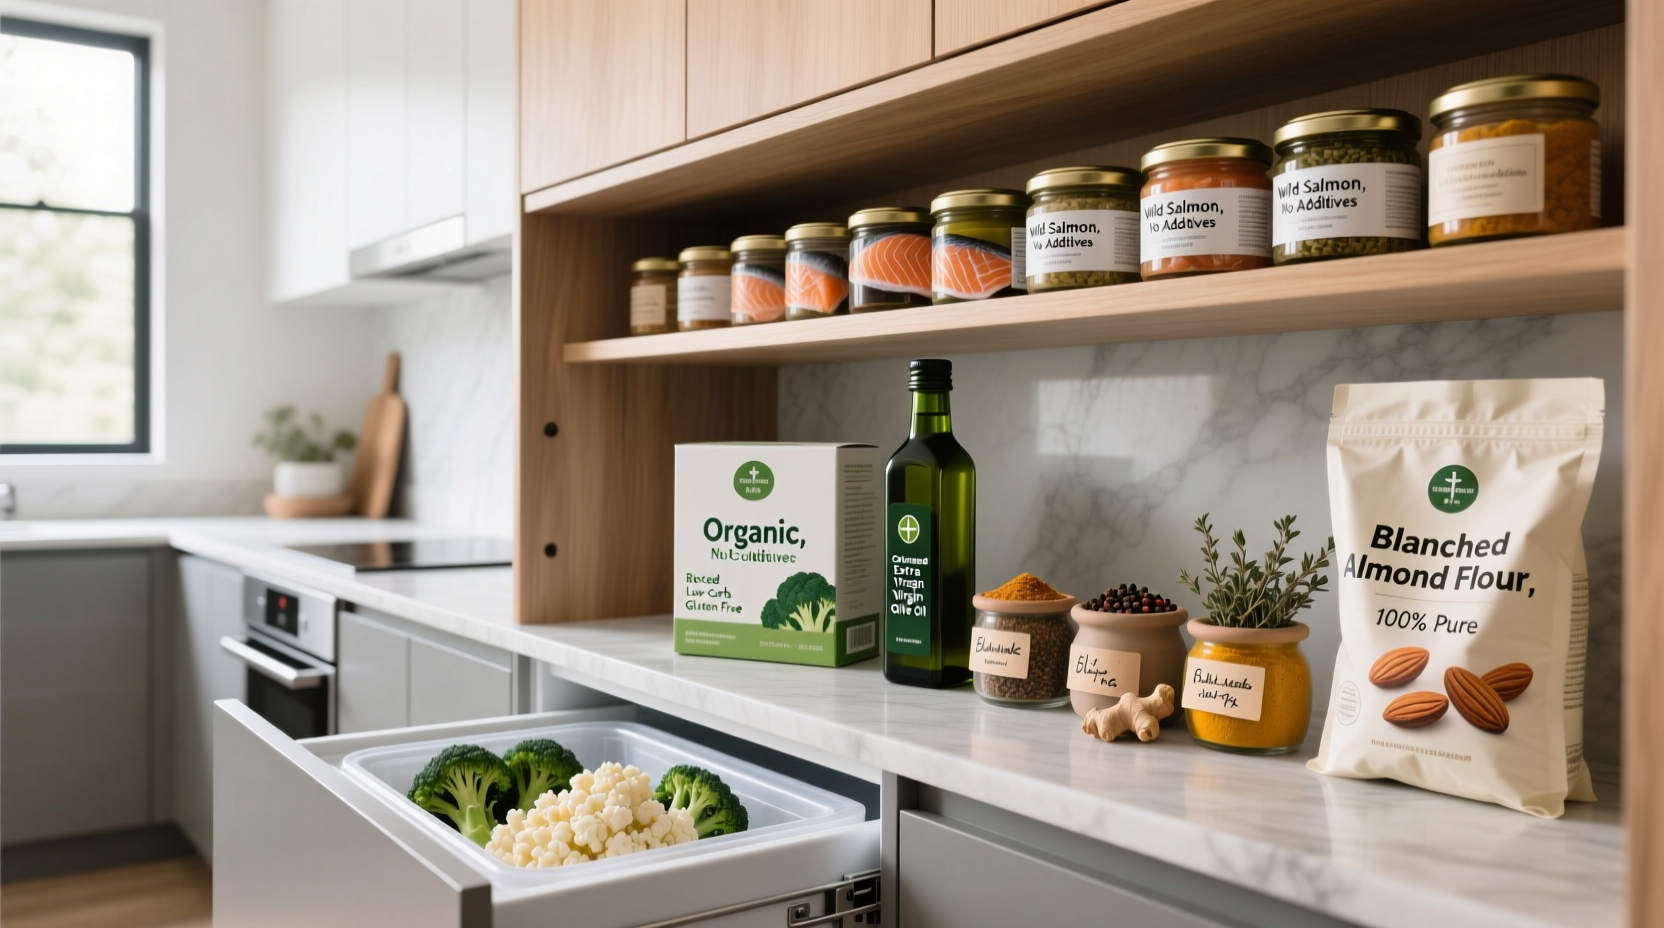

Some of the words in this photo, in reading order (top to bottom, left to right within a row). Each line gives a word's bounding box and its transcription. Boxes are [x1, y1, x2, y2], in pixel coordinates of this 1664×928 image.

[1303, 178, 1366, 194] Salmon,
[1167, 200, 1224, 215] Salmon,
[1048, 221, 1101, 234] Salmon,
[703, 517, 806, 550] Organic,
[1370, 524, 1511, 559] Blanched
[1343, 552, 1450, 590] Almond
[1454, 565, 1536, 598] Flour,
[1376, 607, 1427, 632] 100%
[1433, 614, 1478, 635] Pure
